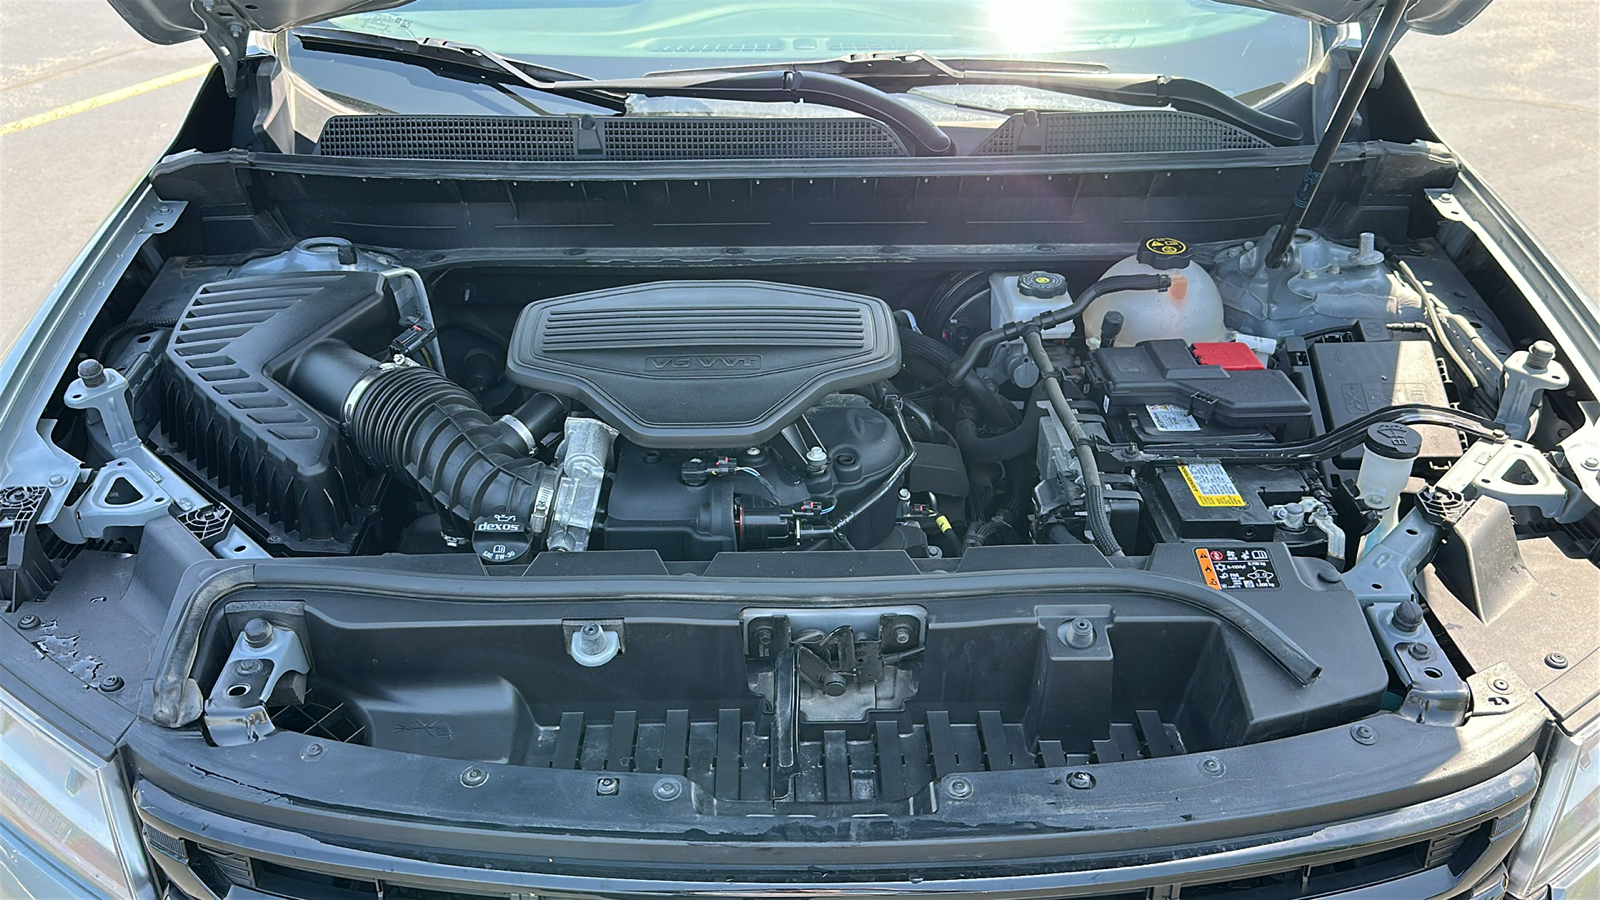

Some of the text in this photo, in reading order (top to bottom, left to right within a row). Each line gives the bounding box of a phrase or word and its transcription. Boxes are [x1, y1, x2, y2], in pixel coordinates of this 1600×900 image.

[649, 357, 757, 368] V6 VVT
[478, 522, 520, 531] dexos
[494, 550, 516, 560] 5W-30
